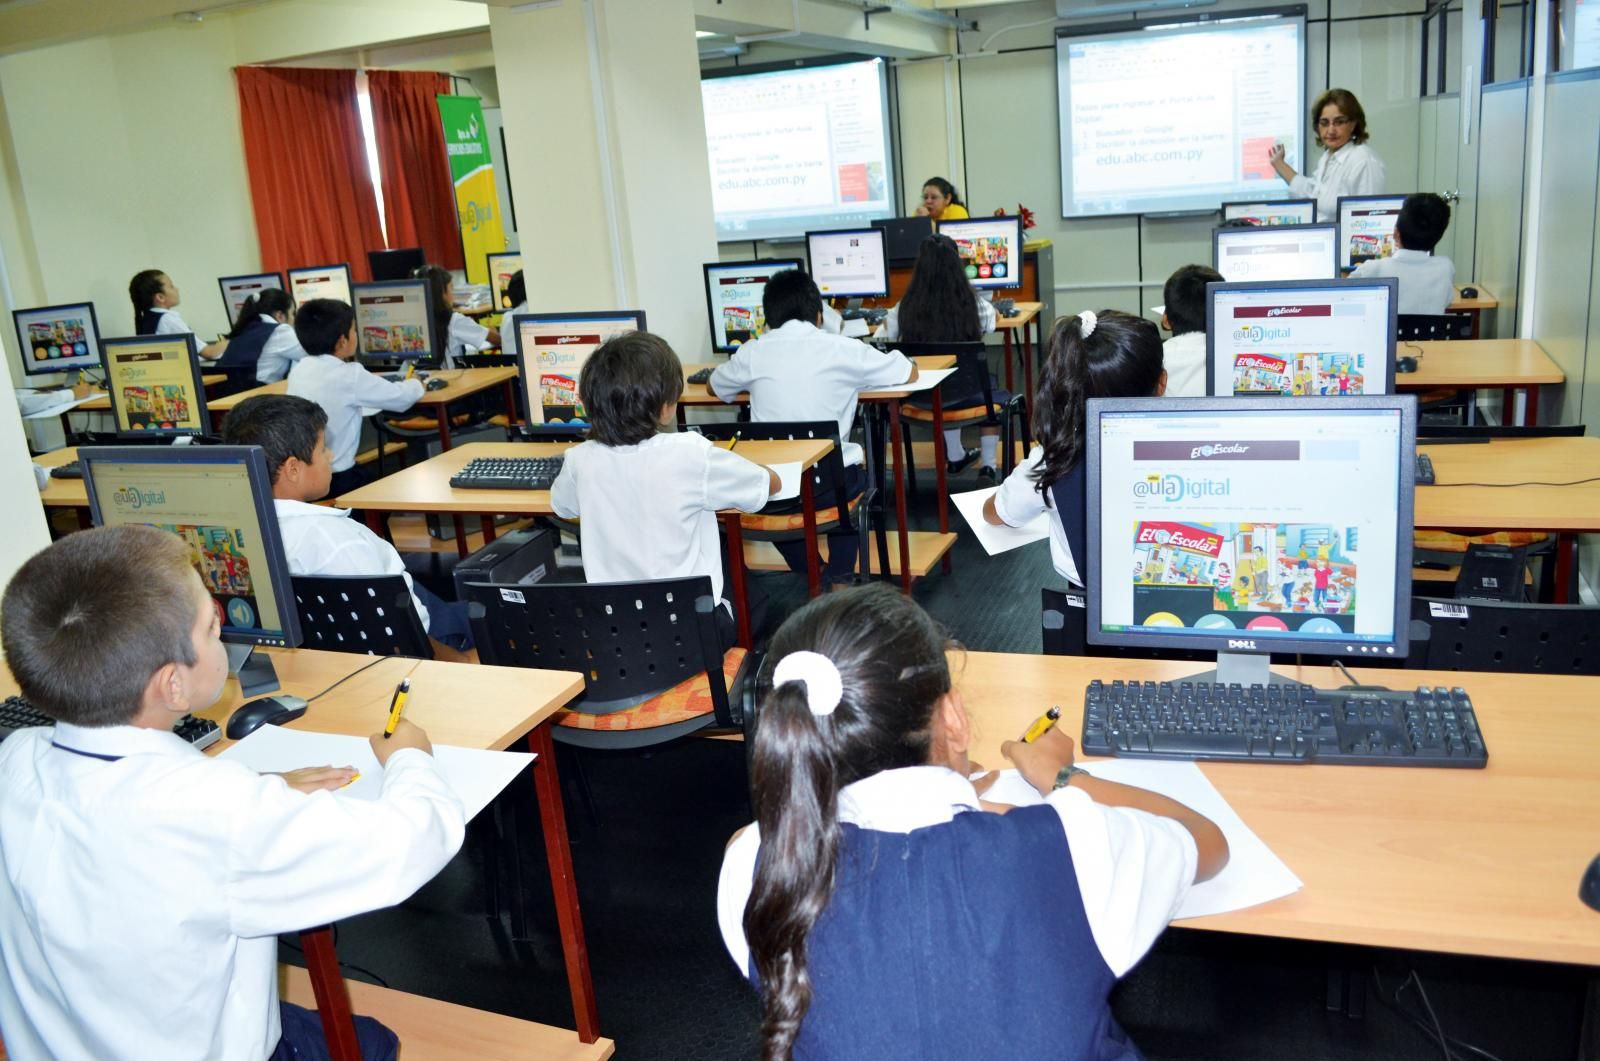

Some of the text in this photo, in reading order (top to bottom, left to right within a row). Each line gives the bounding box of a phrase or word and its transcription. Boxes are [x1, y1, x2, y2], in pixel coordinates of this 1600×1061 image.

[1096, 149, 1204, 165] edu.abc.com.py
[718, 175, 808, 190] edu.abc.com.py
[1190, 443, 1250, 459] El Escolar
[1139, 528, 1218, 553] El Escolar
[1228, 639, 1257, 650] DELL
